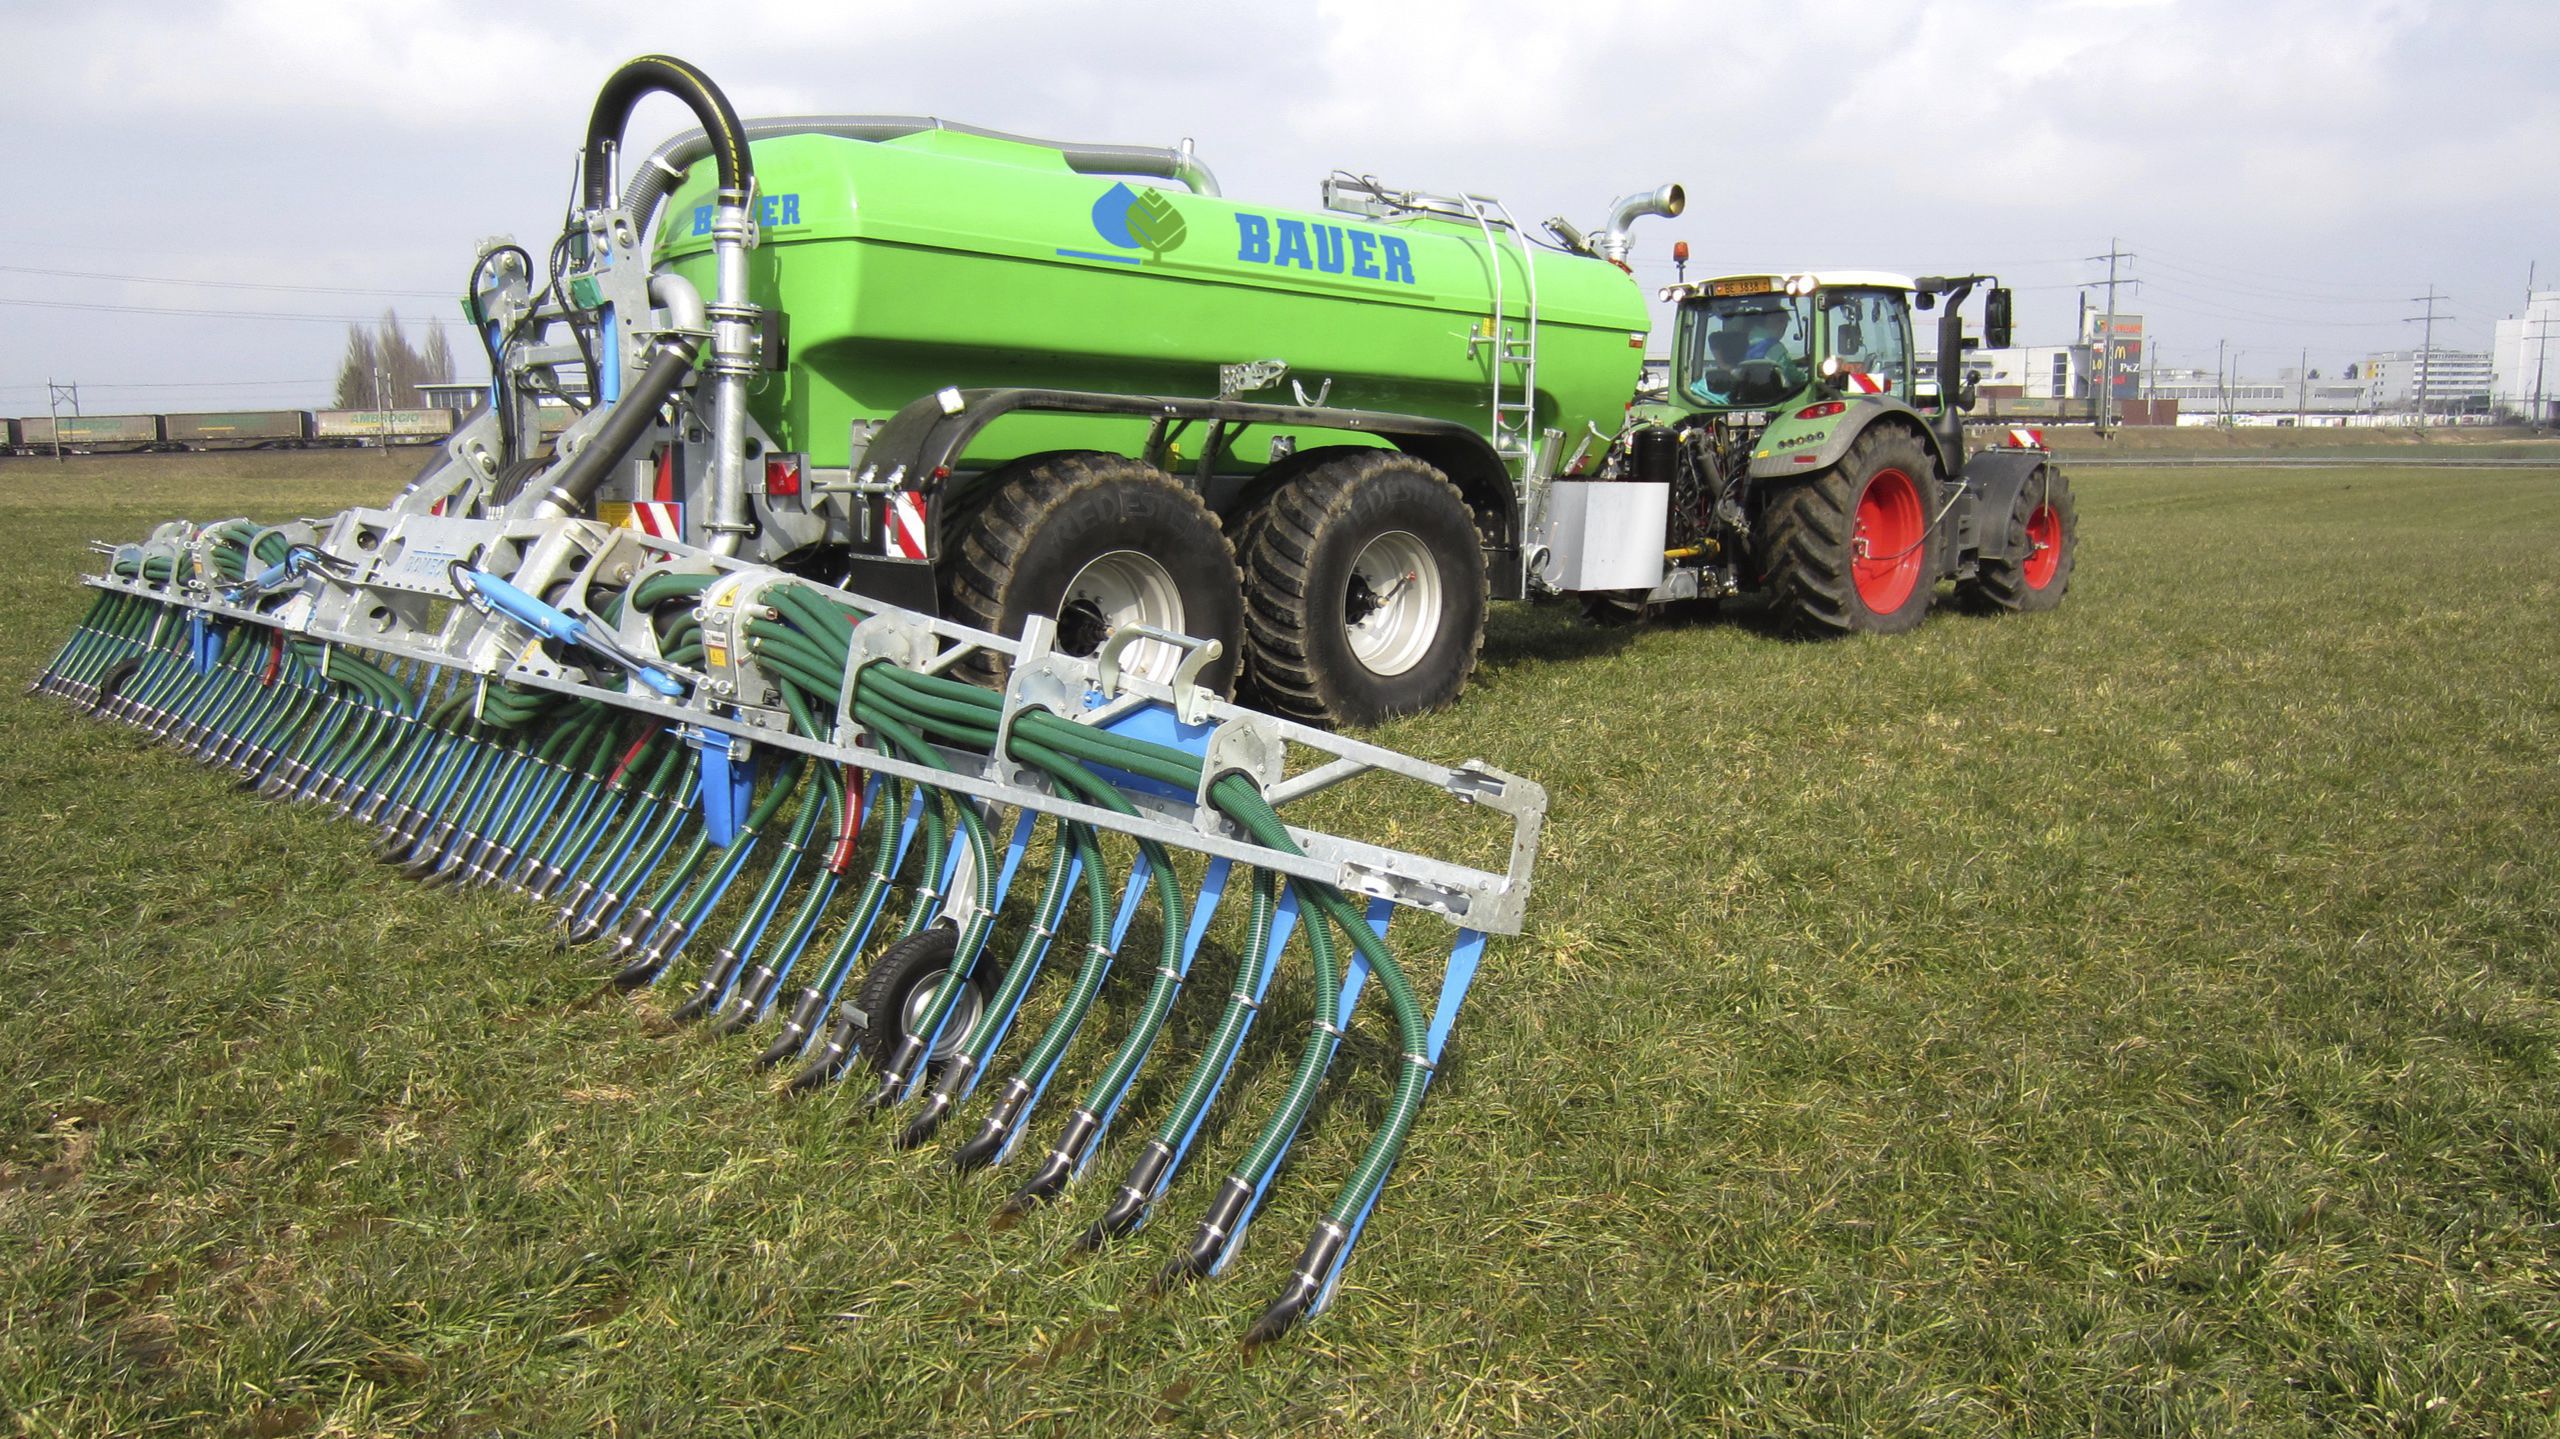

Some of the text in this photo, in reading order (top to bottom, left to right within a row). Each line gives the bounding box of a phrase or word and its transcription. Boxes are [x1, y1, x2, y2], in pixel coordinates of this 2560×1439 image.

[692, 193, 801, 236] BER
[1234, 212, 1416, 285] BAUER
[403, 556, 450, 578] BOMEC
